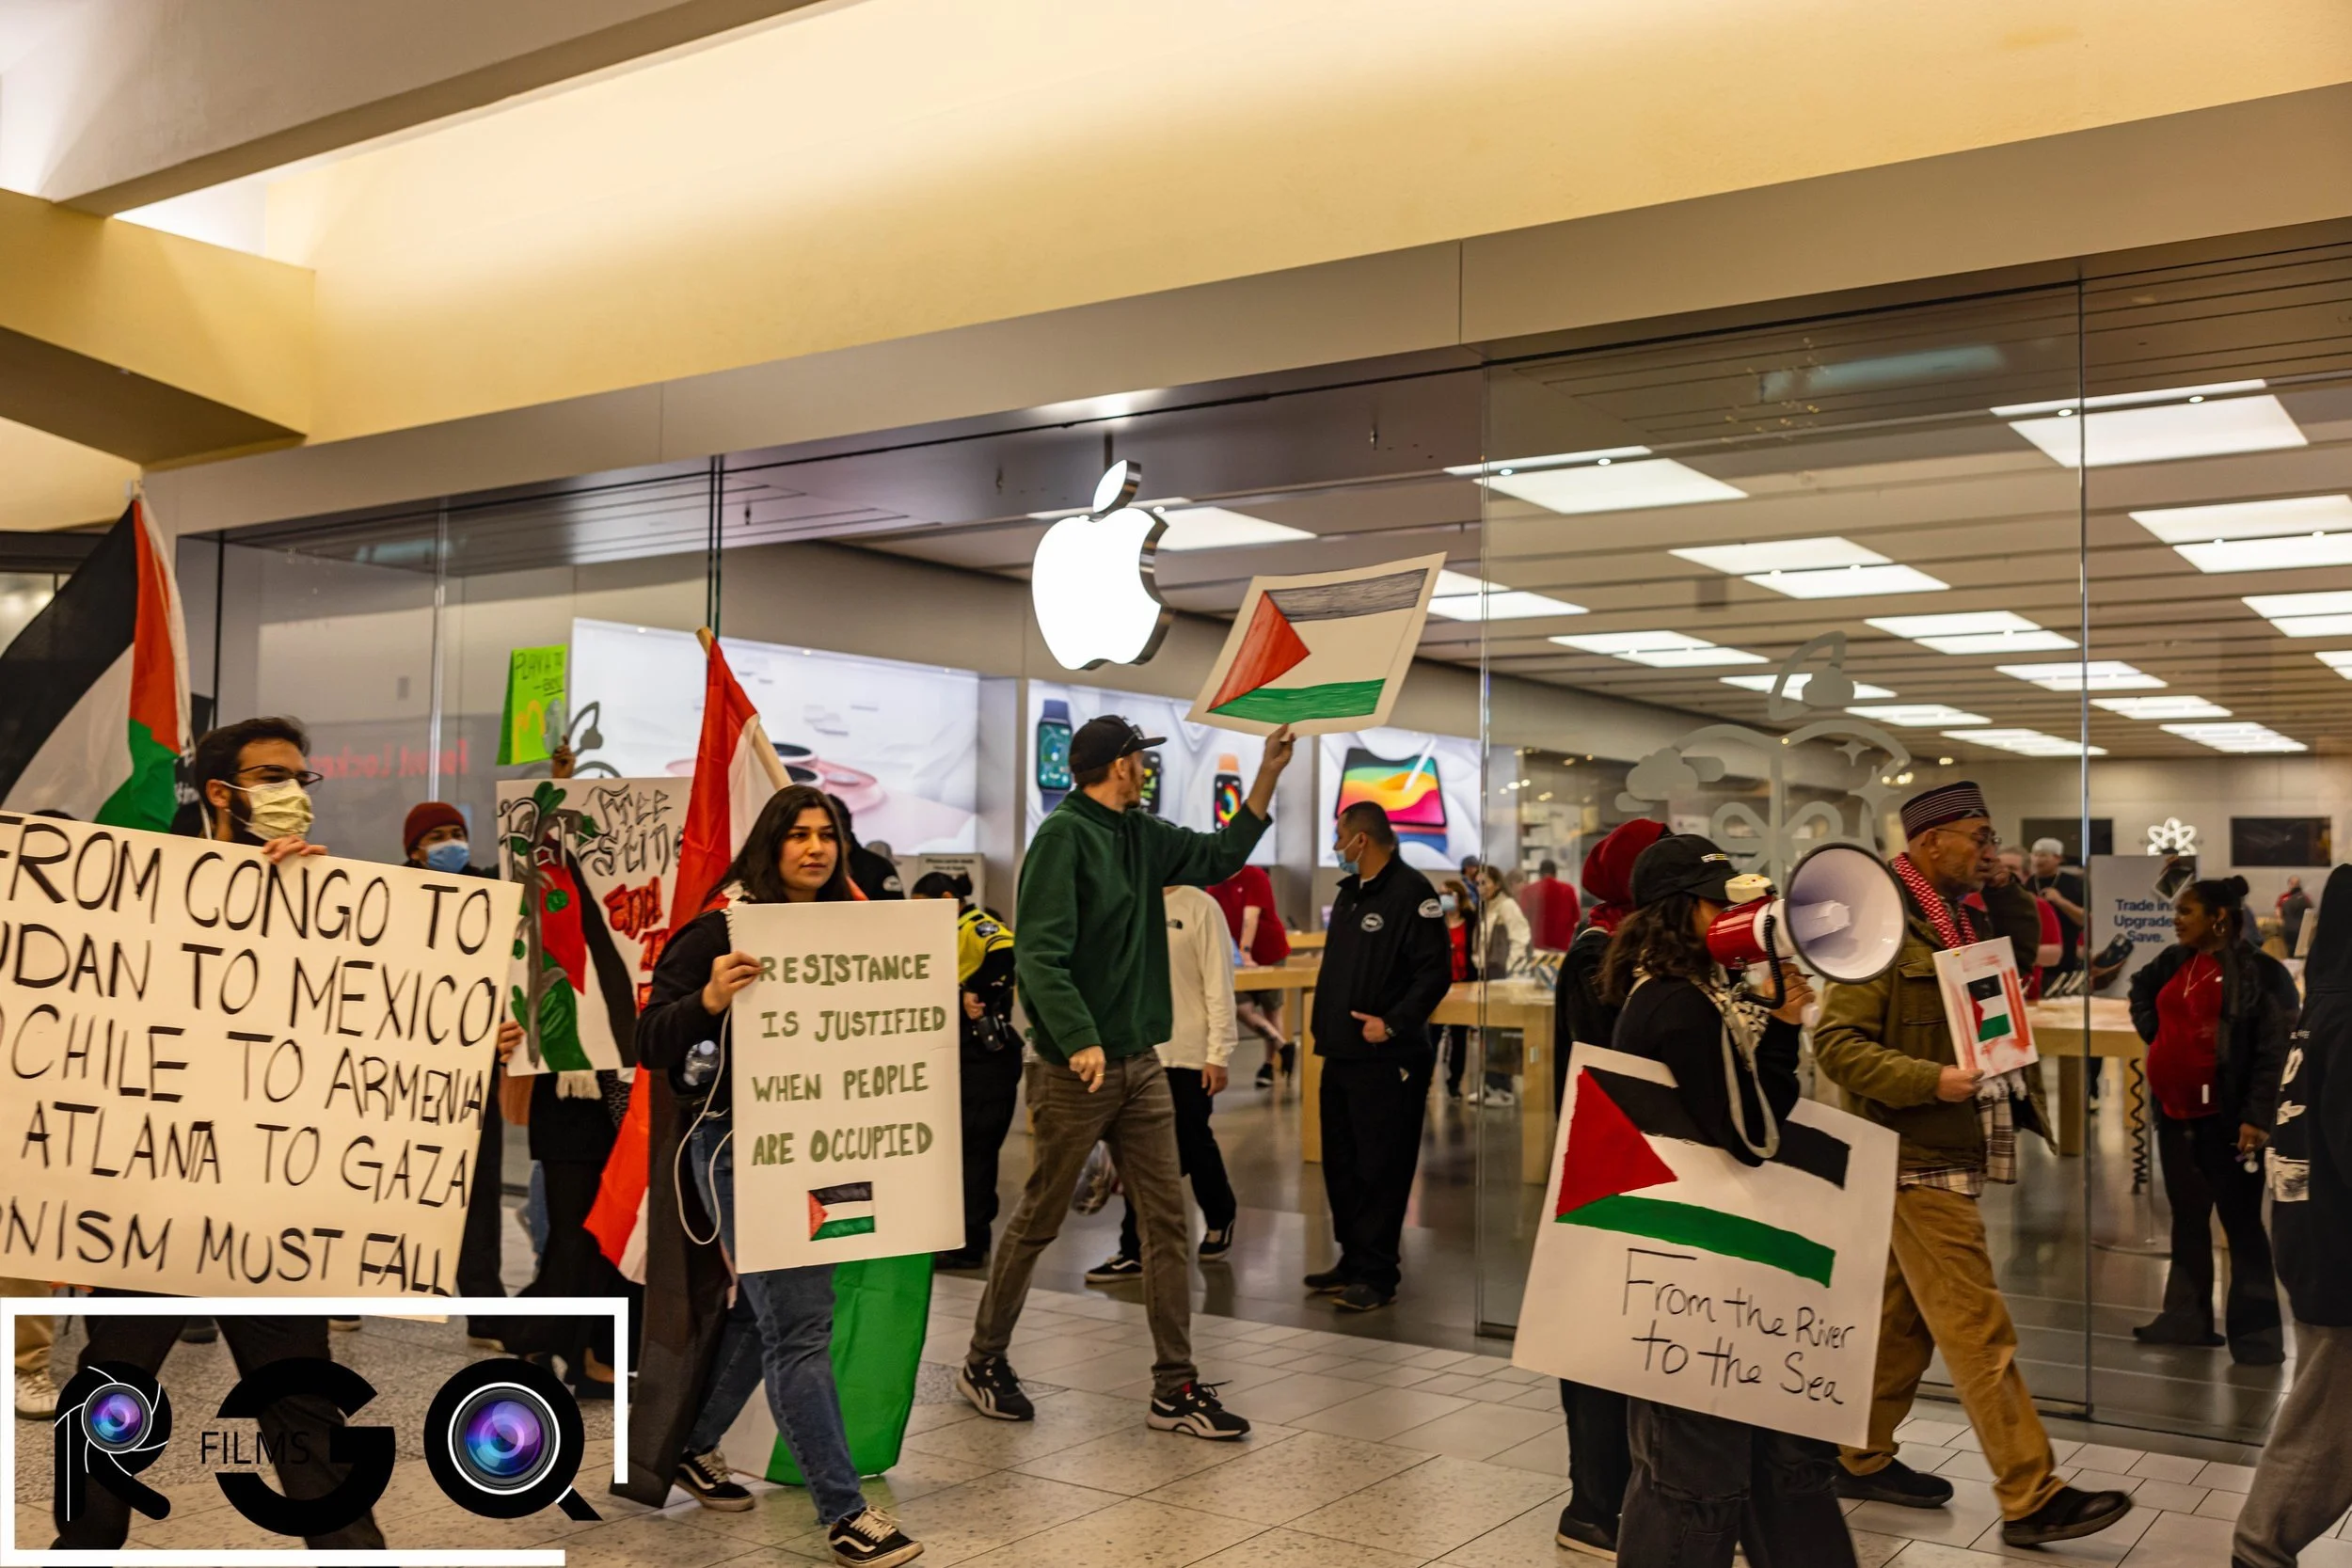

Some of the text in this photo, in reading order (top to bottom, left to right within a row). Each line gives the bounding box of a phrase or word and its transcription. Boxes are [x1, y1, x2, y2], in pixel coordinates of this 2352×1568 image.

[185, 851, 390, 946] CONGO
[421, 883, 492, 956] TO
[2114, 898, 2154, 911] Trade
[182, 943, 259, 1015] TO
[290, 956, 497, 1047] MEXICO
[759, 953, 930, 986] RESISTANCE
[760, 1006, 946, 1042] IS JUSTIFIED
[11, 1004, 189, 1102] CHILE
[227, 1031, 305, 1102] TO
[325, 1048, 485, 1130] ARMENIA
[752, 1061, 929, 1102] WHEN PEOPLE
[255, 1123, 320, 1186] TO
[341, 1135, 469, 1209] GAZA
[752, 1121, 933, 1166] ARE OCCUPIED
[196, 1216, 344, 1284] MUST
[358, 1232, 453, 1297] FALL
[1622, 1247, 1855, 1349] From the River
[1630, 1319, 1844, 1405] to the Sea
